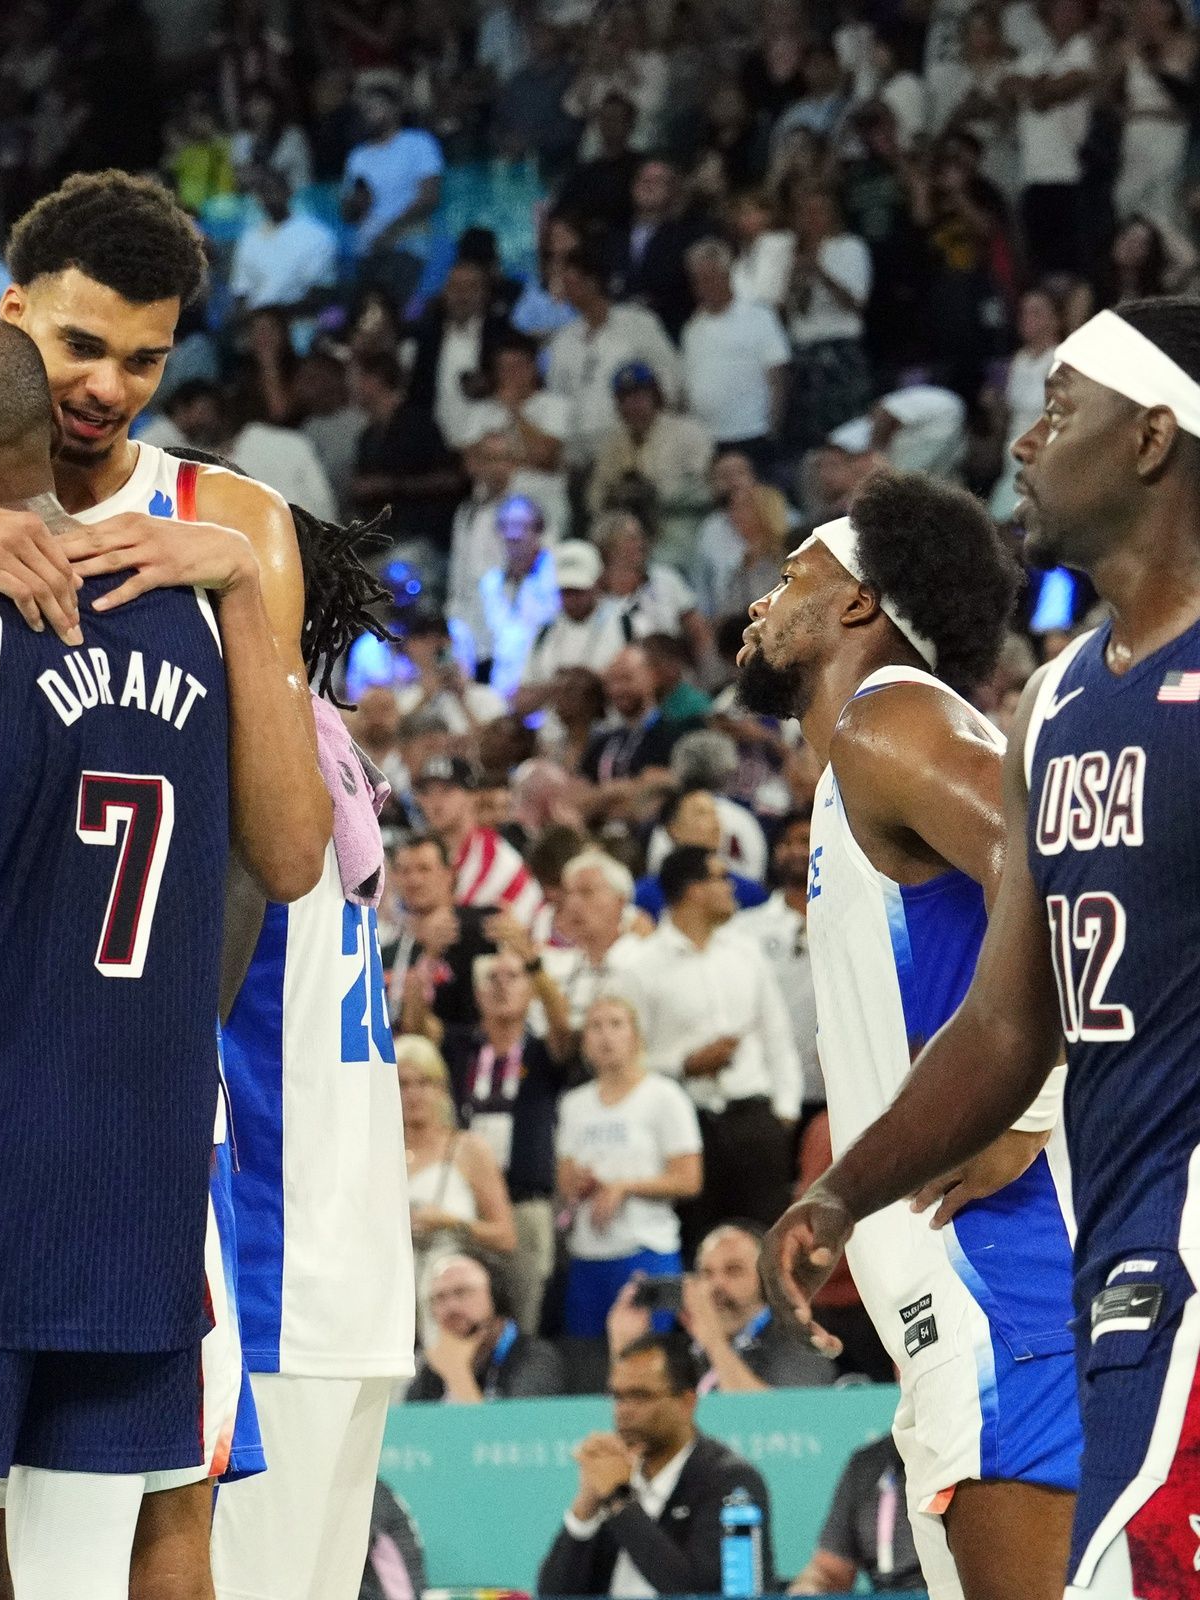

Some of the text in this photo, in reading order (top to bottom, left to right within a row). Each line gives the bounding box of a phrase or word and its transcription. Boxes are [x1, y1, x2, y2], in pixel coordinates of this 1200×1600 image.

[37, 648, 207, 730] DURANT
[1036, 746, 1146, 856] USA
[75, 770, 174, 979] 7
[1046, 892, 1135, 1043] 12
[920, 1325, 929, 1339] 54
